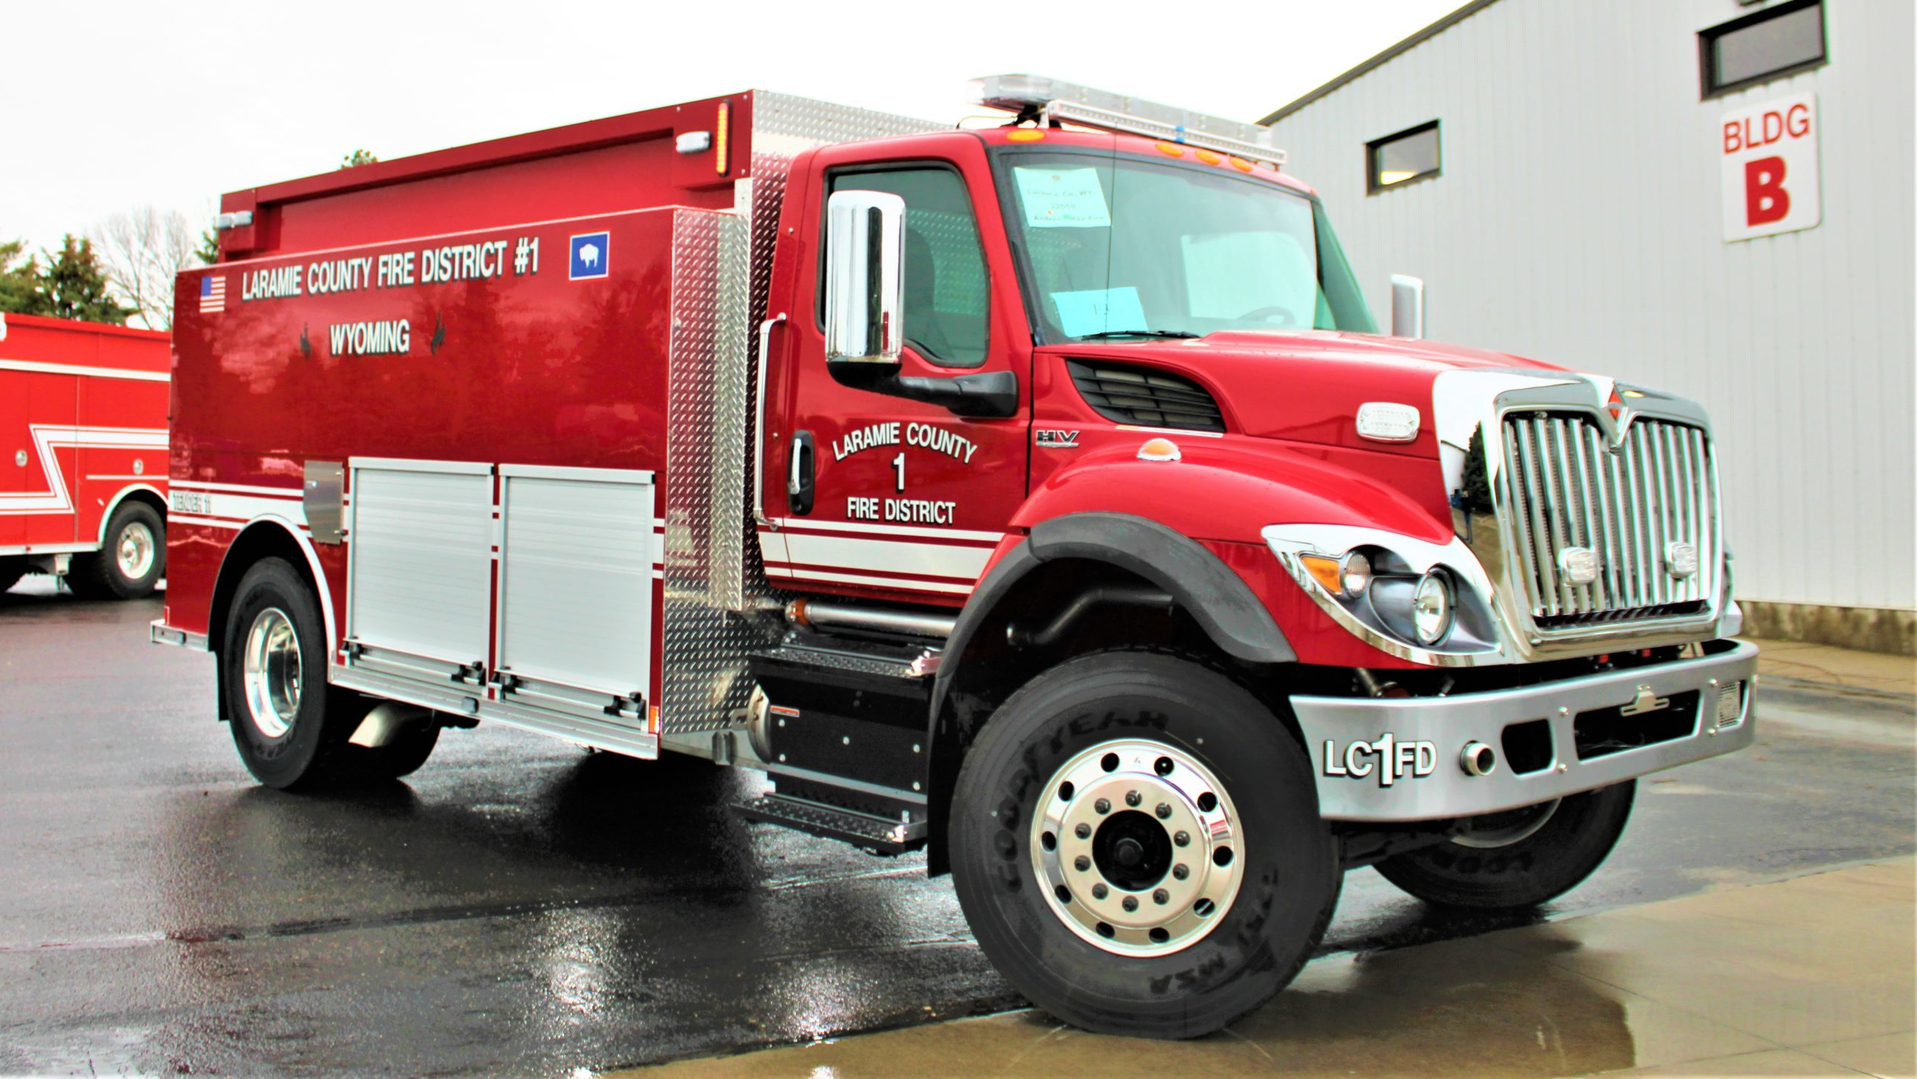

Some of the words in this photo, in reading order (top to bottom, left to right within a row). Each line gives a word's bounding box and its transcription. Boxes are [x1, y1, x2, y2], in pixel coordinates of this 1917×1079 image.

[1723, 103, 1810, 155] BLDG
[1744, 155, 1791, 228] B
[242, 262, 302, 300] LARAMIE
[307, 256, 372, 295] COUNTY
[377, 252, 416, 287] FIRE
[421, 241, 507, 283] DISTRICT
[514, 237, 539, 274] #1
[330, 318, 410, 355] WYOMING
[833, 422, 900, 461] LARAMIE
[907, 422, 977, 464] COUNTY
[1036, 429, 1080, 444] HV
[892, 451, 905, 490] 1
[847, 496, 880, 520] FIRE
[885, 498, 956, 524] DISTRICT
[1324, 733, 1438, 785] LC1FD
[994, 710, 1171, 894] GOODYEAR
